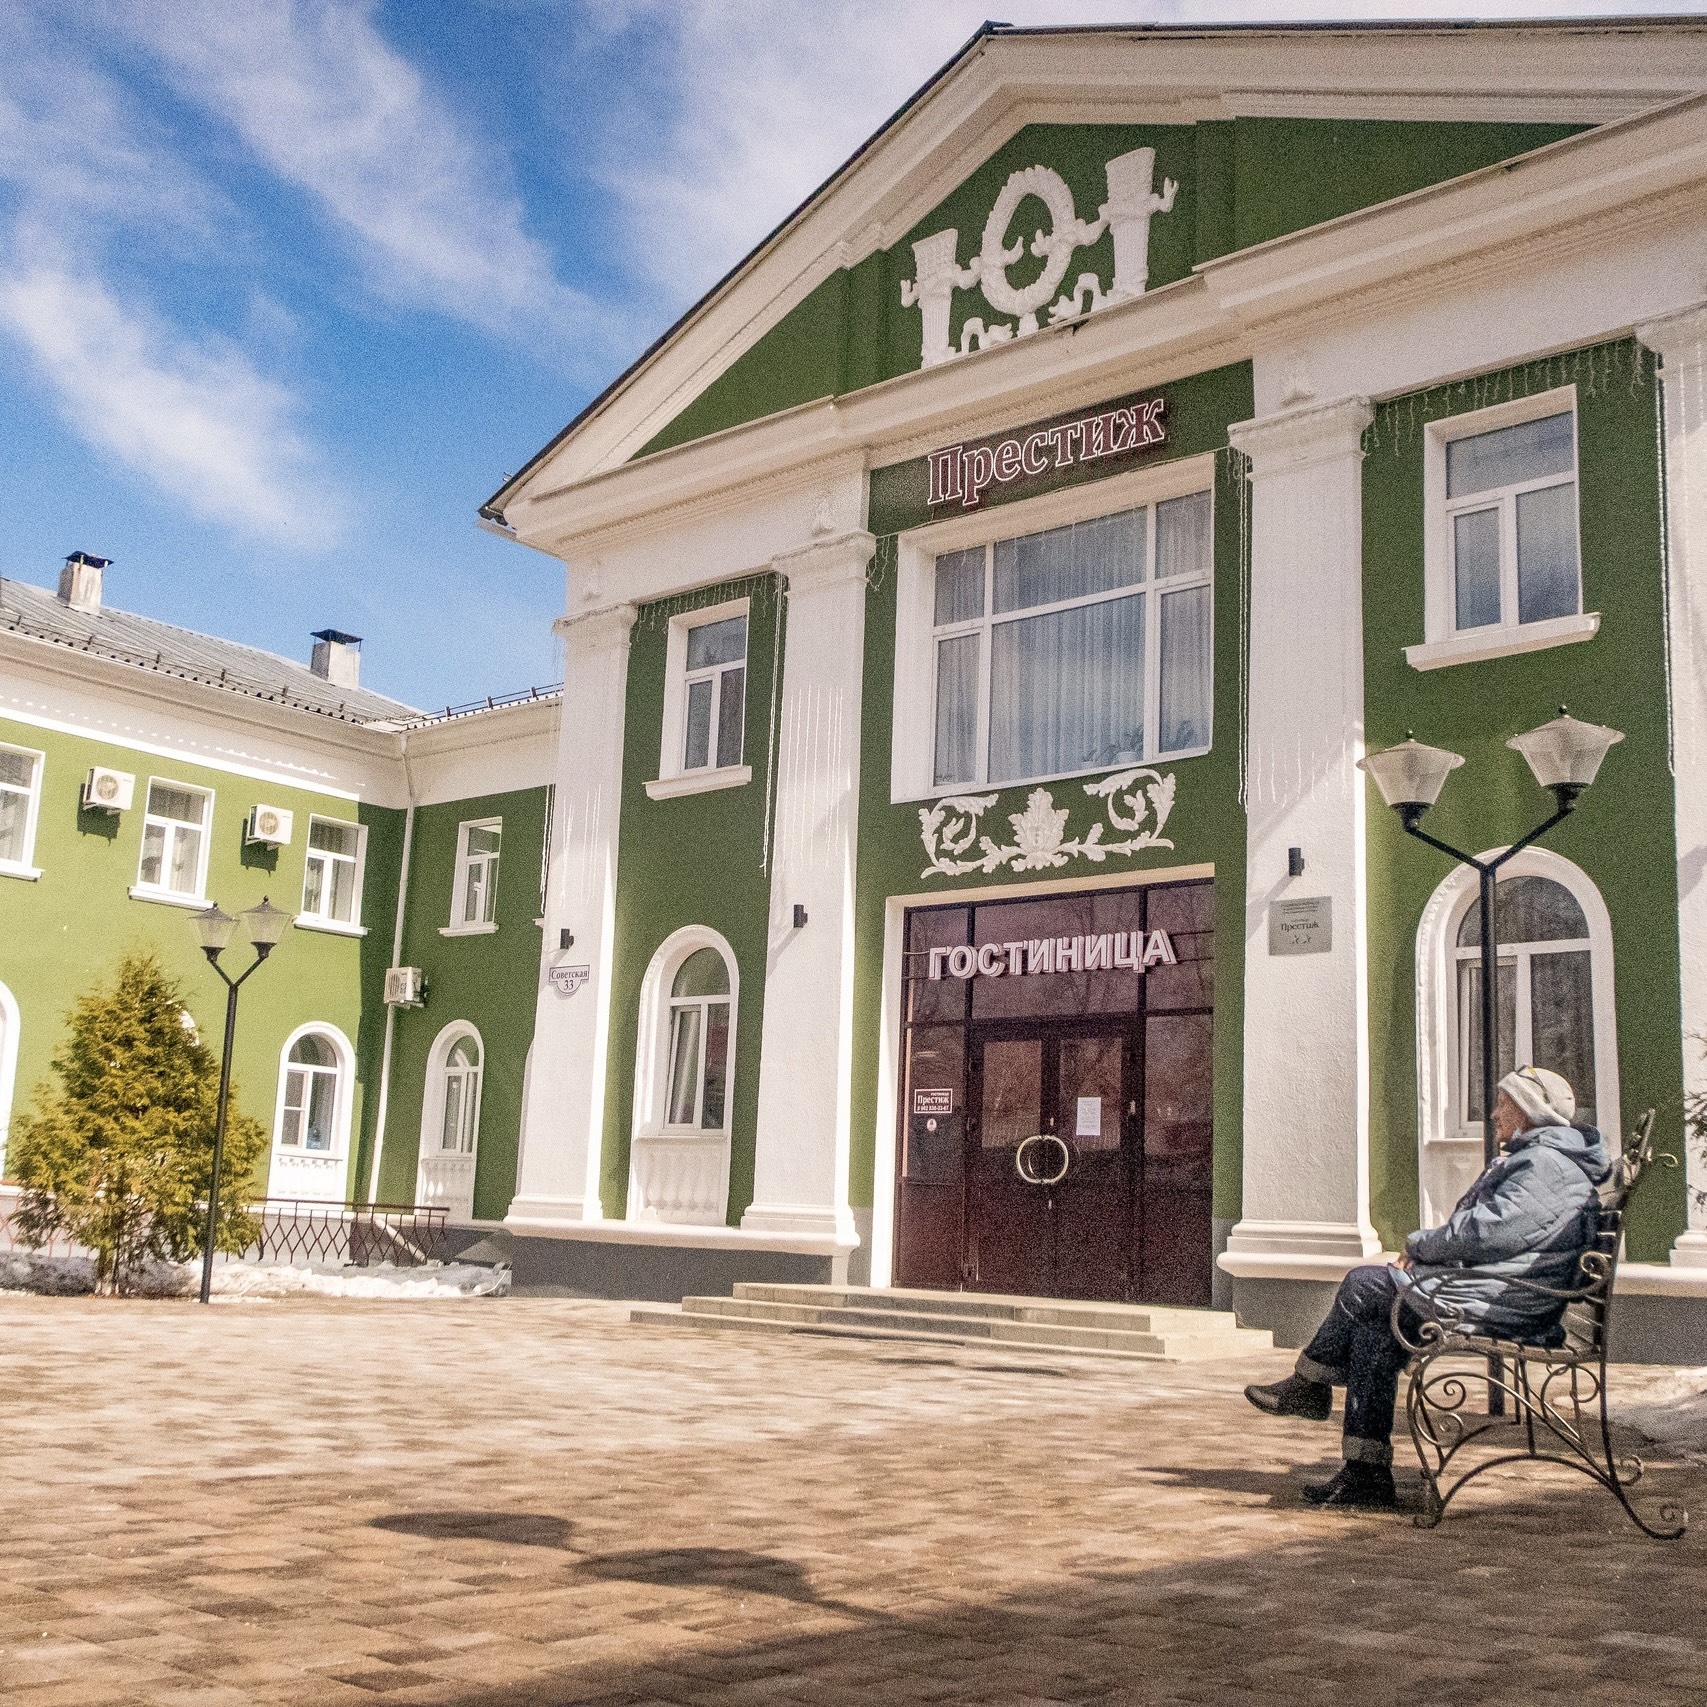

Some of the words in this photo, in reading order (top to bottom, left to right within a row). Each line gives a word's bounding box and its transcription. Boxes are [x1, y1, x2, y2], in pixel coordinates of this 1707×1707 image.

[928, 399, 1164, 506] Престиж
[1281, 922, 1319, 932] Престиж
[928, 928, 1178, 981] ГОСТИНИЦА
[551, 970, 587, 979] Советская
[564, 980, 574, 990] 33
[917, 1095, 949, 1105] Престиж
